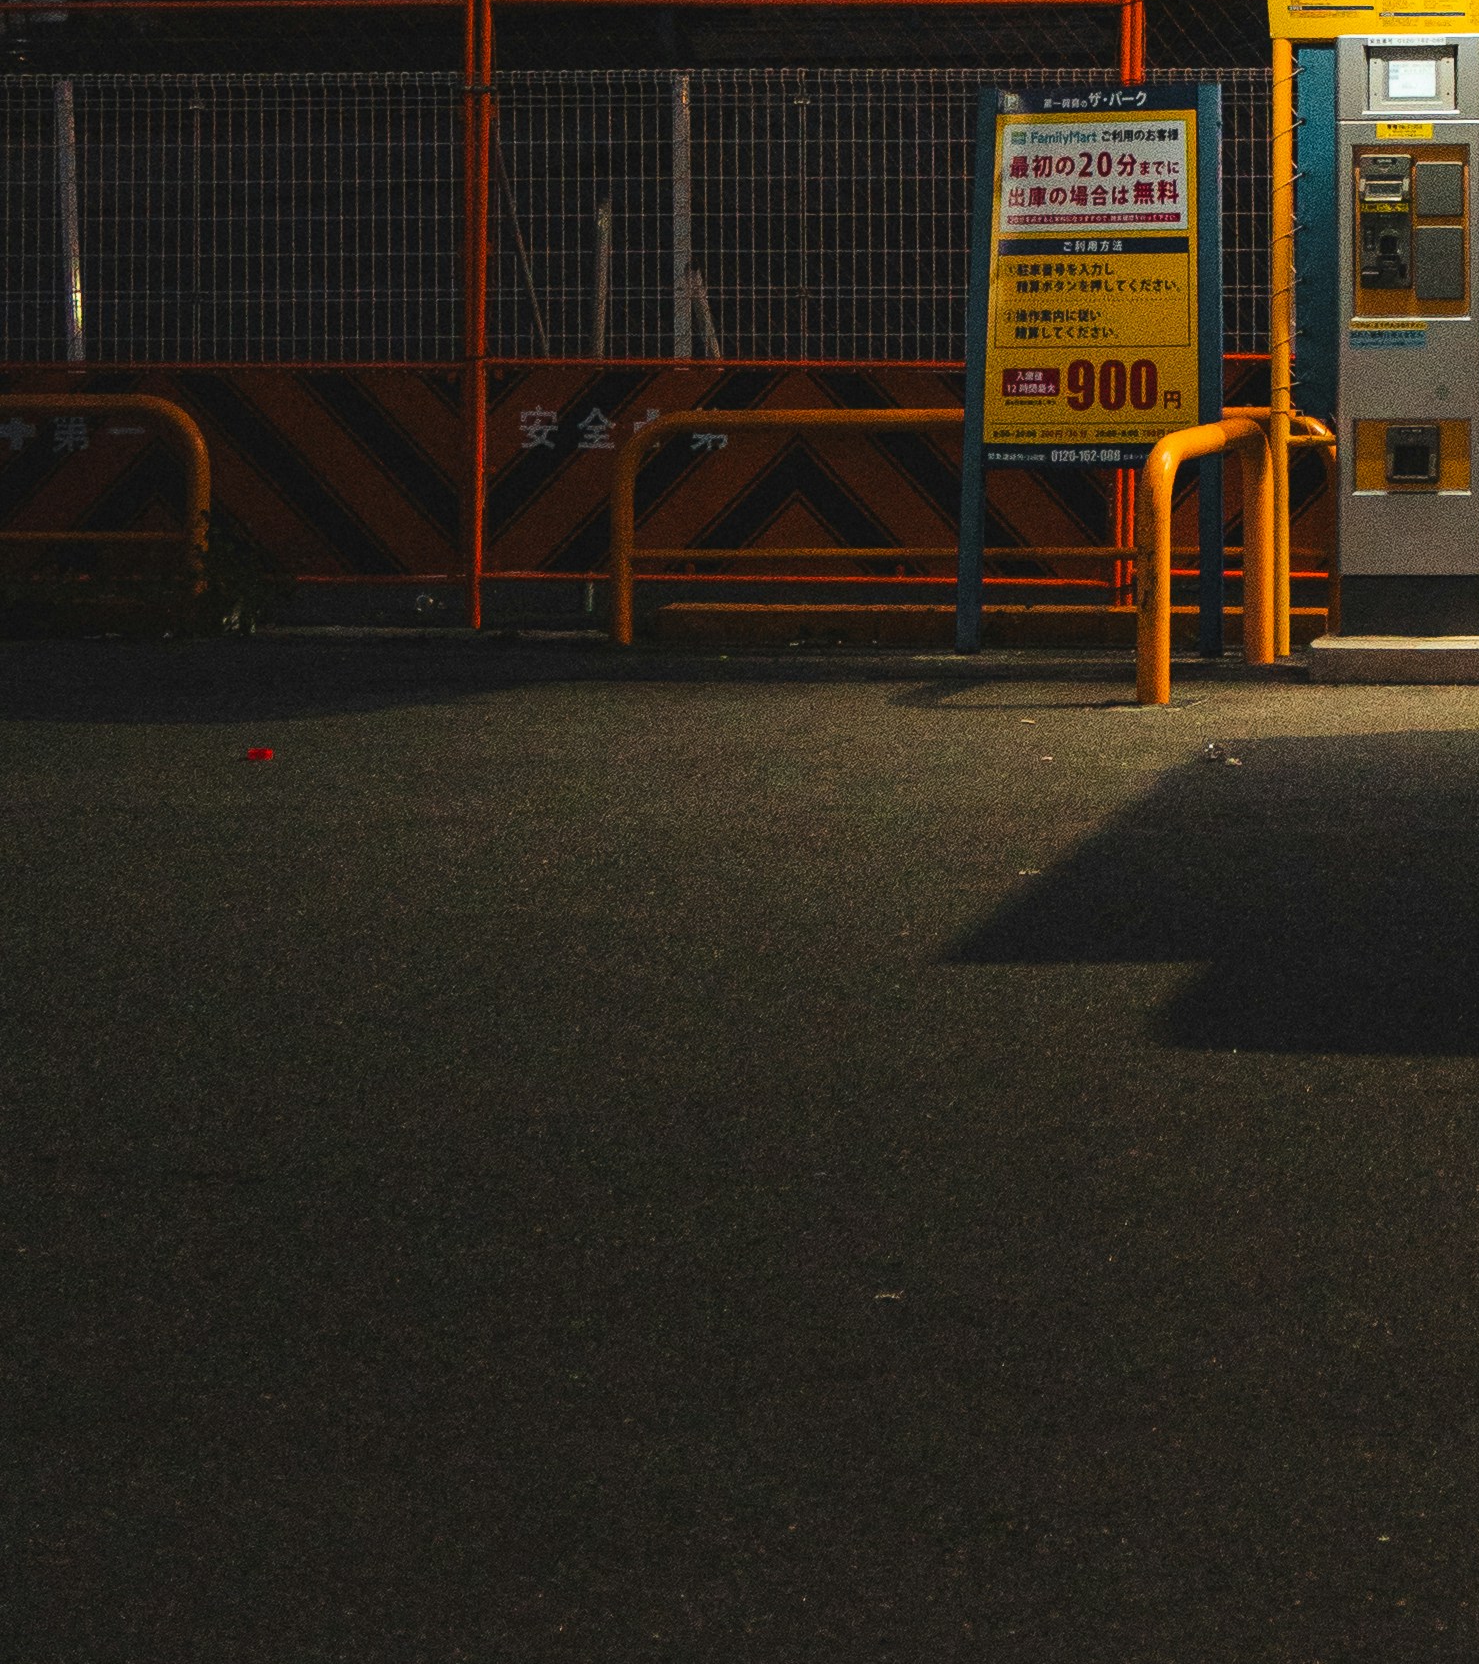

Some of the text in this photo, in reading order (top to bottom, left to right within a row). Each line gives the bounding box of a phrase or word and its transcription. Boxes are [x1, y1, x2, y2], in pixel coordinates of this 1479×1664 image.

[1030, 128, 1179, 145] FamilyMart ご利用のお客様
